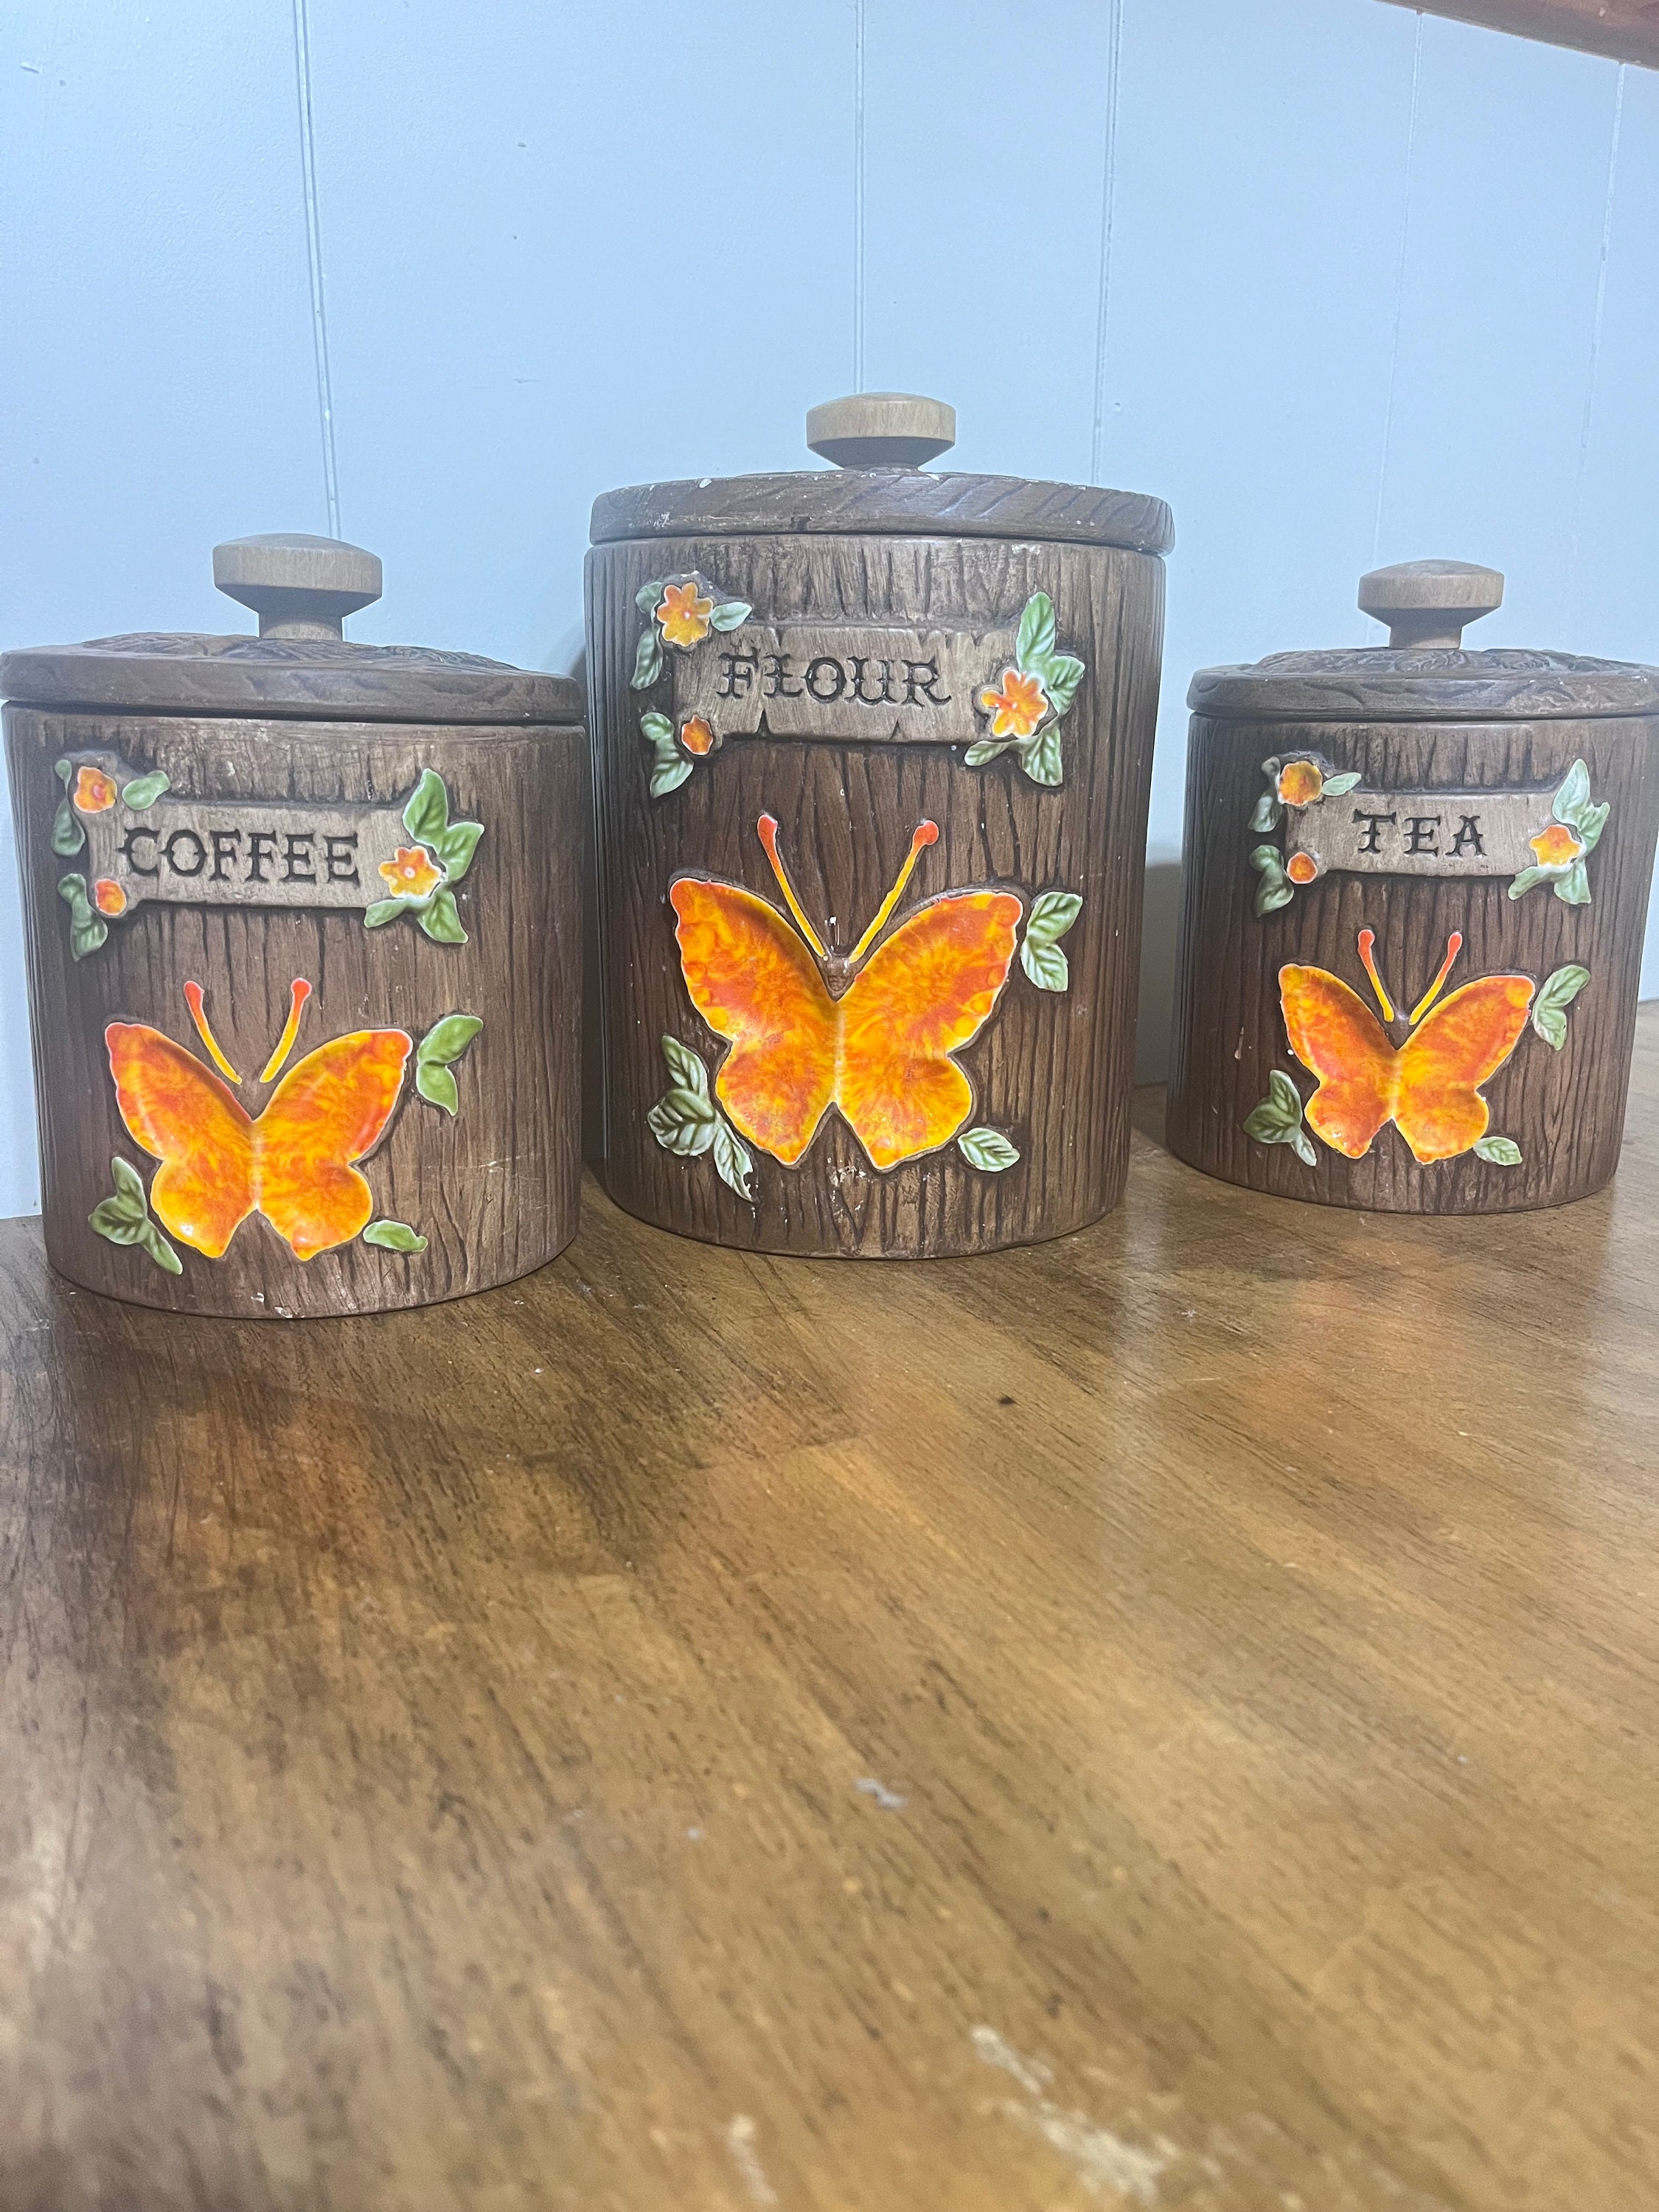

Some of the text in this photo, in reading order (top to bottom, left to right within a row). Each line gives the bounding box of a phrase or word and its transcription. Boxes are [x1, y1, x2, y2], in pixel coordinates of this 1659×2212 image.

[717, 647, 951, 707] FLOUR
[117, 827, 361, 886] COFFEE
[1352, 809, 1487, 857] TEA
